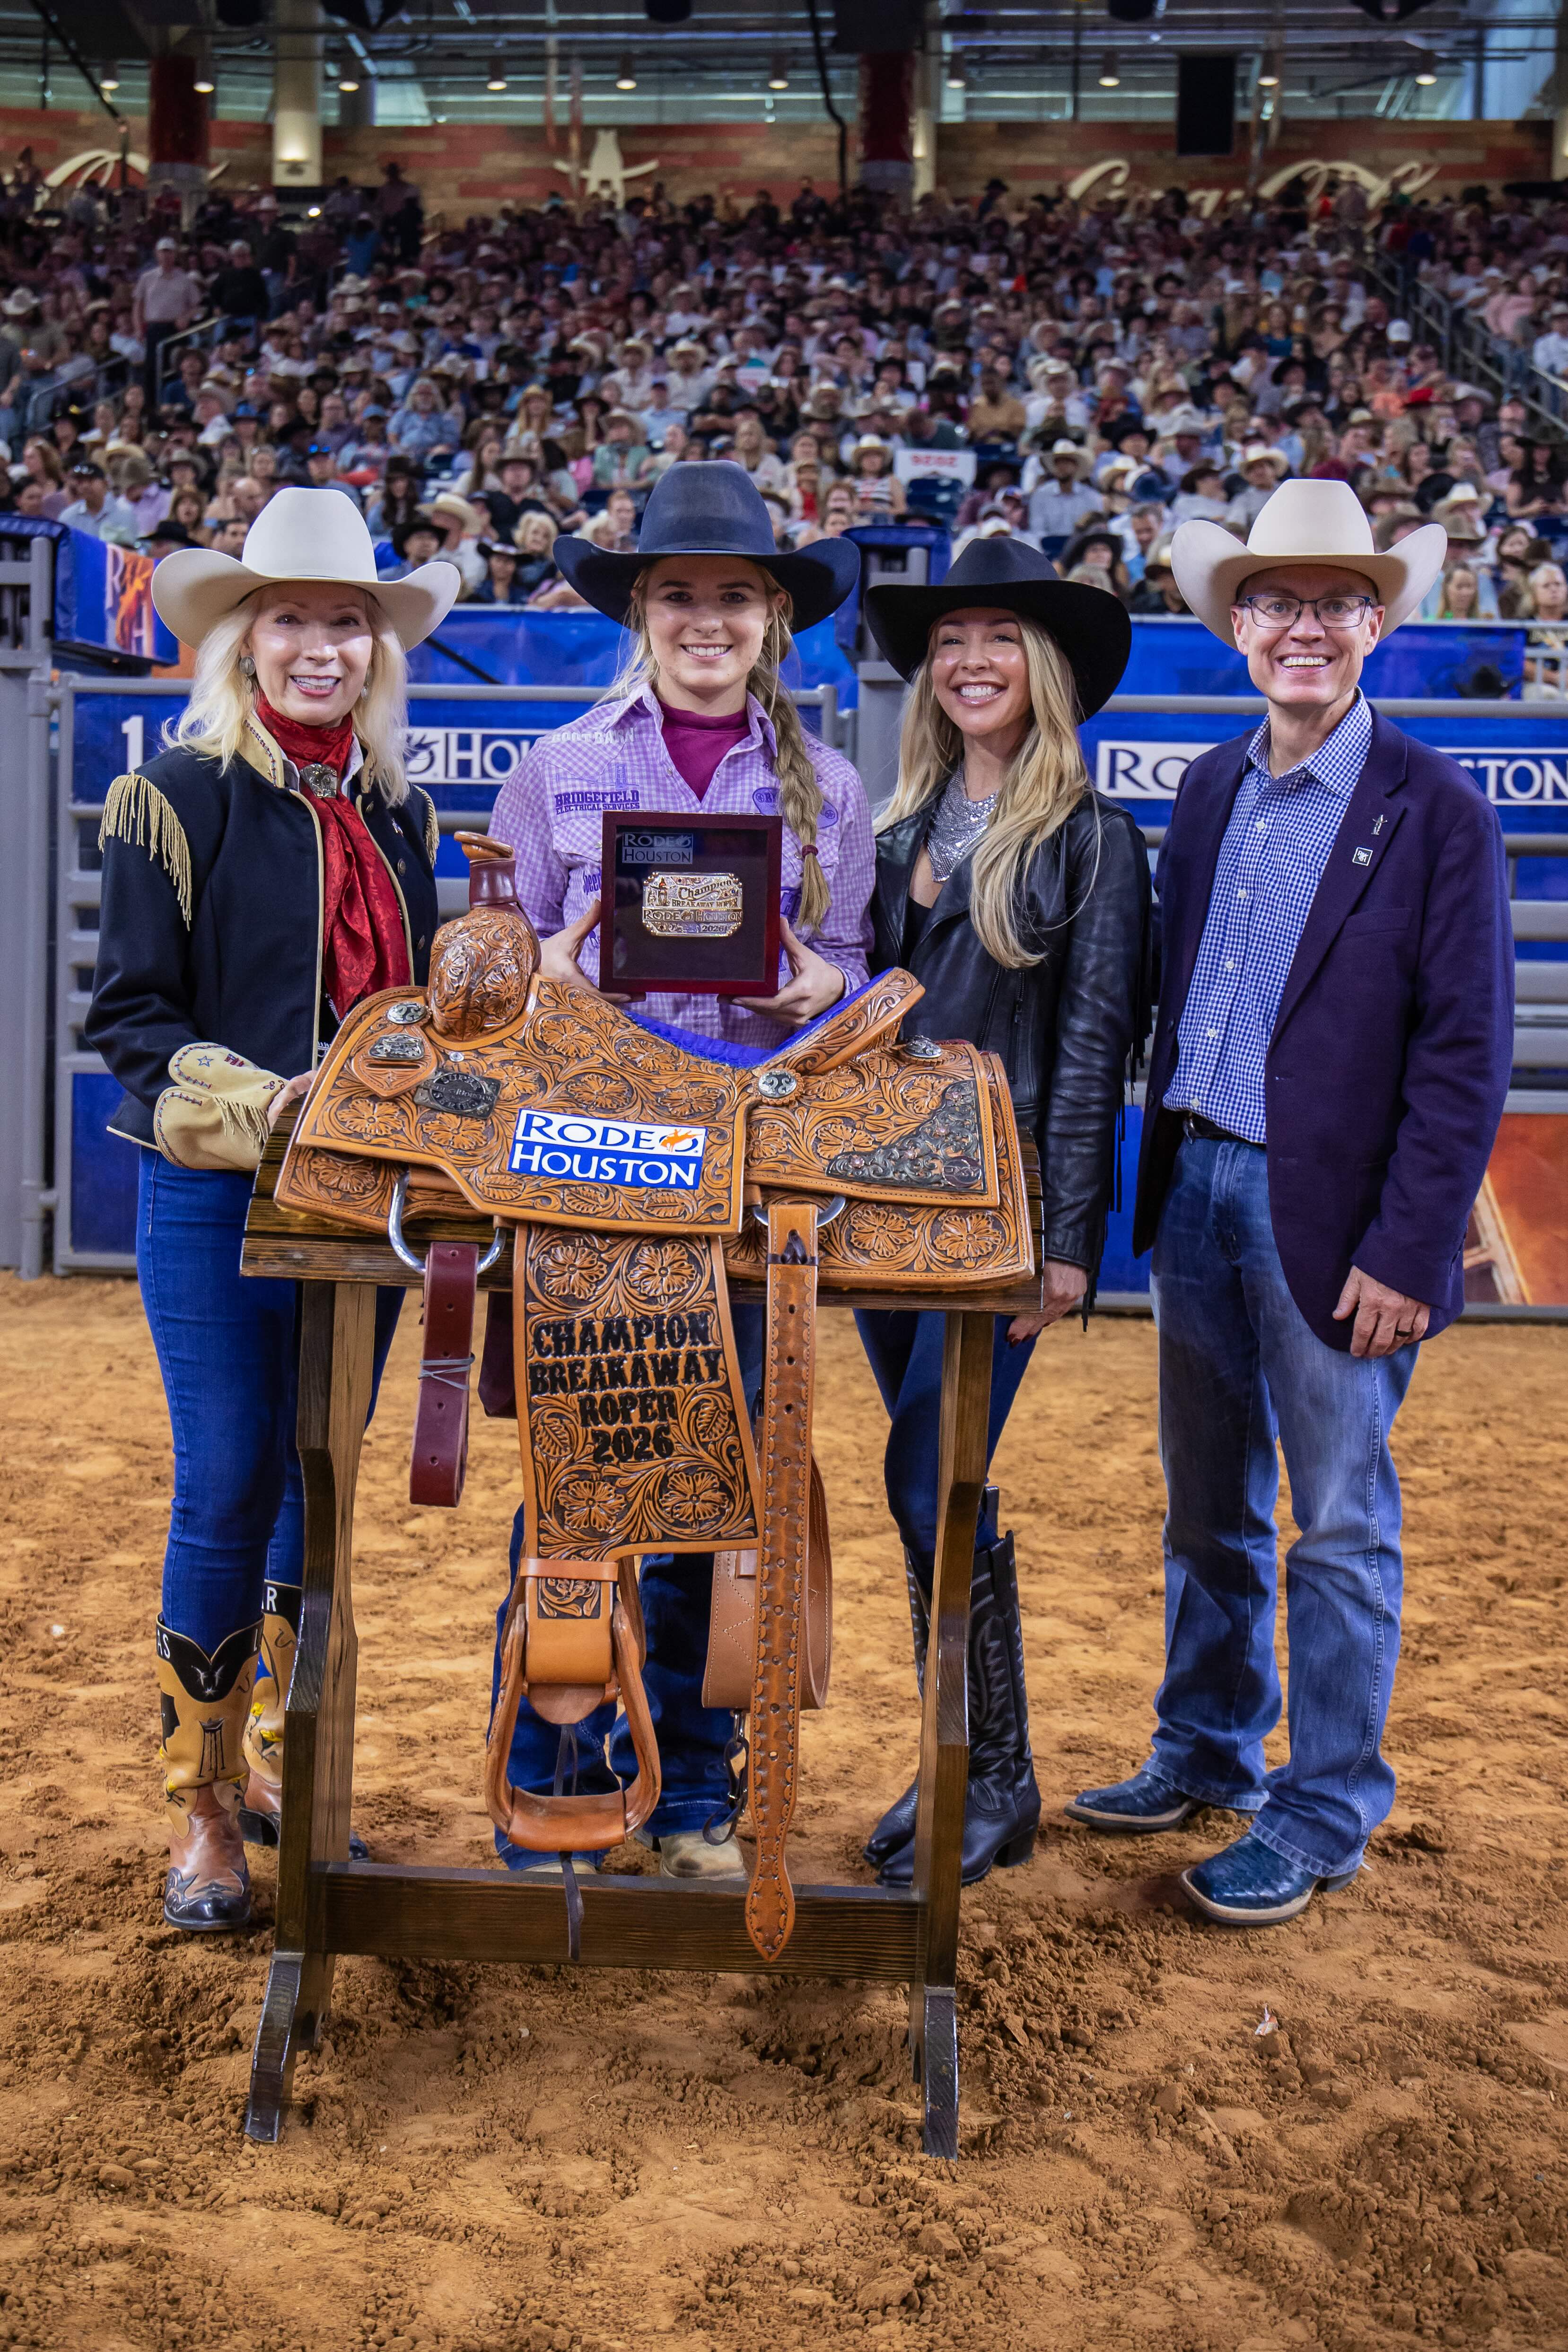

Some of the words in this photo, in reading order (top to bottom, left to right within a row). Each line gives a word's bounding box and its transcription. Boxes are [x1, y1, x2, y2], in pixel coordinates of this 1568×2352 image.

[552, 732, 591, 743] BOOT
[594, 727, 635, 744] BARN
[555, 790, 640, 807] BRIDGEFIELD
[556, 803, 601, 815] ELECTRICAL
[602, 803, 640, 811] SERVICES
[624, 849, 691, 862] HOUSTON
[678, 880, 732, 900] Champion
[672, 899, 714, 907] BREAKAWAY
[695, 909, 743, 922] HOUSTON
[522, 1113, 699, 1153] RODEO
[511, 1143, 697, 1186] HOUSTON
[533, 1312, 711, 1358] CHAMPION
[528, 1349, 723, 1397] BREAKAWAY
[578, 1390, 677, 1427] ROPER
[591, 1425, 674, 1463] 2026
